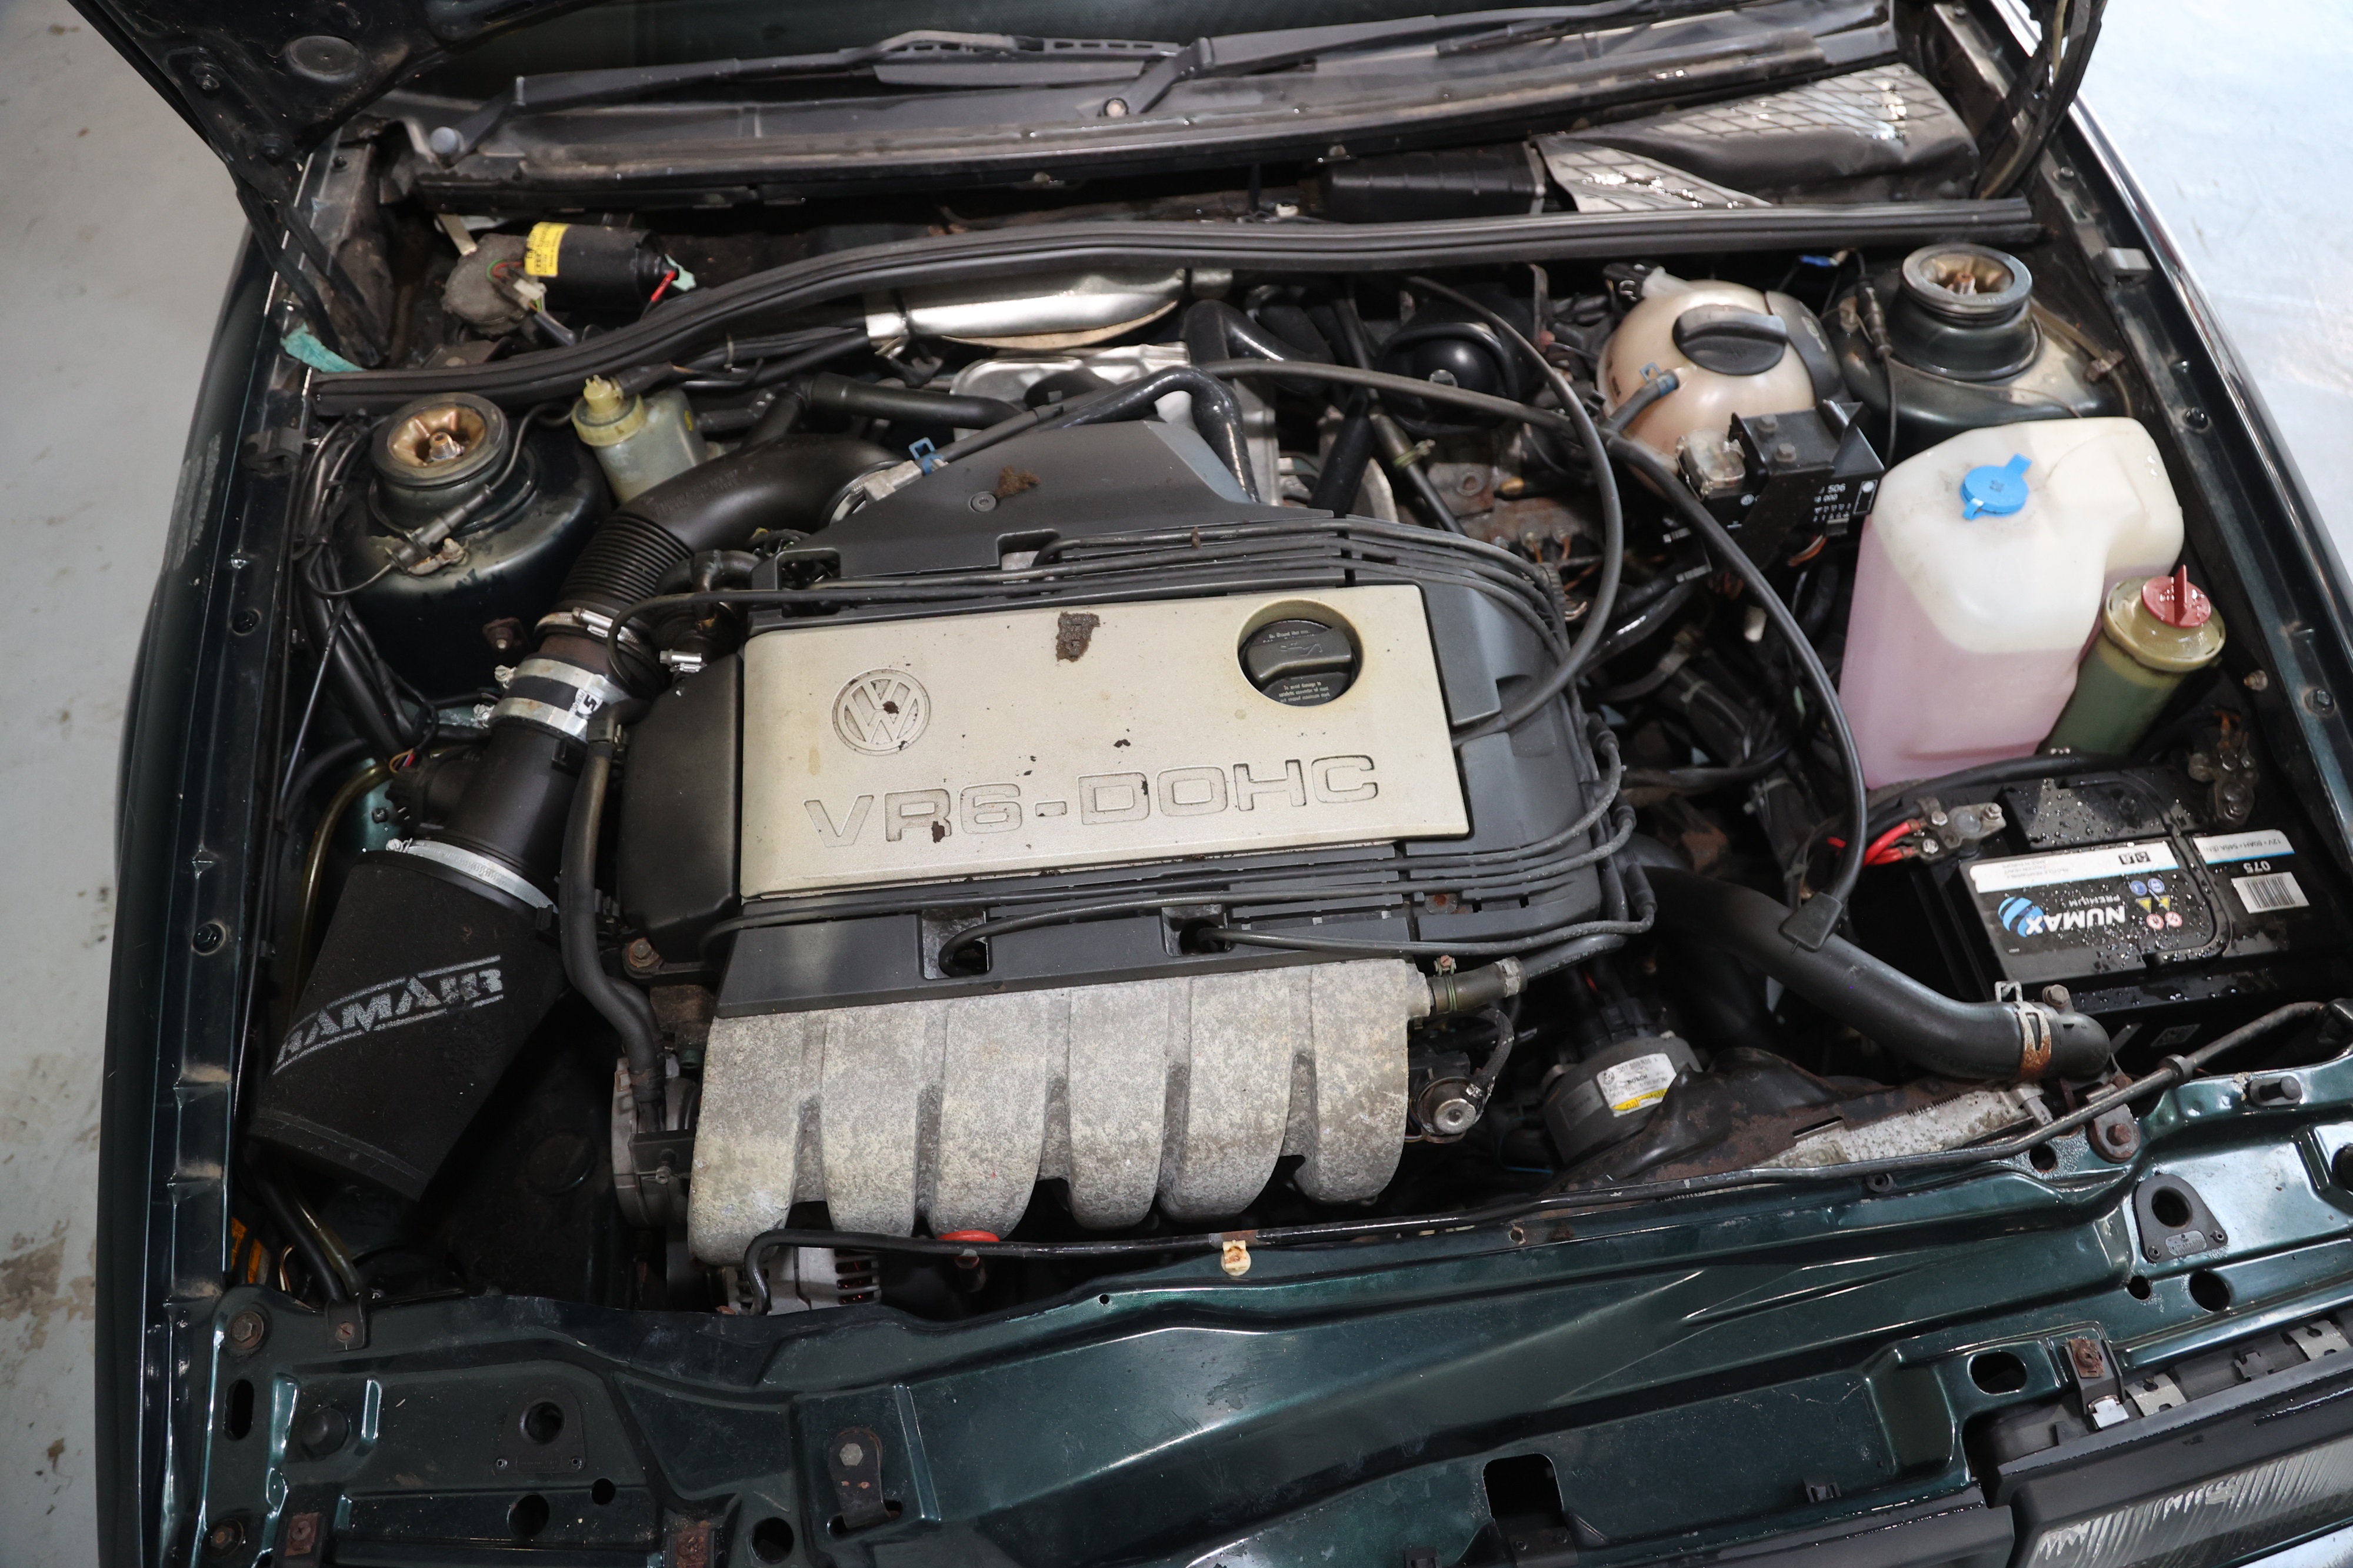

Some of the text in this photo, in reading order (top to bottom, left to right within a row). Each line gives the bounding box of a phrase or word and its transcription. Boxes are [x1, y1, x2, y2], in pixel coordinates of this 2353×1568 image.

[804, 754, 1377, 848] VR6-DOHC
[2242, 860, 2271, 873] 075
[2068, 894, 2121, 908] PREMIUM
[2025, 905, 2125, 936] NUMAX
